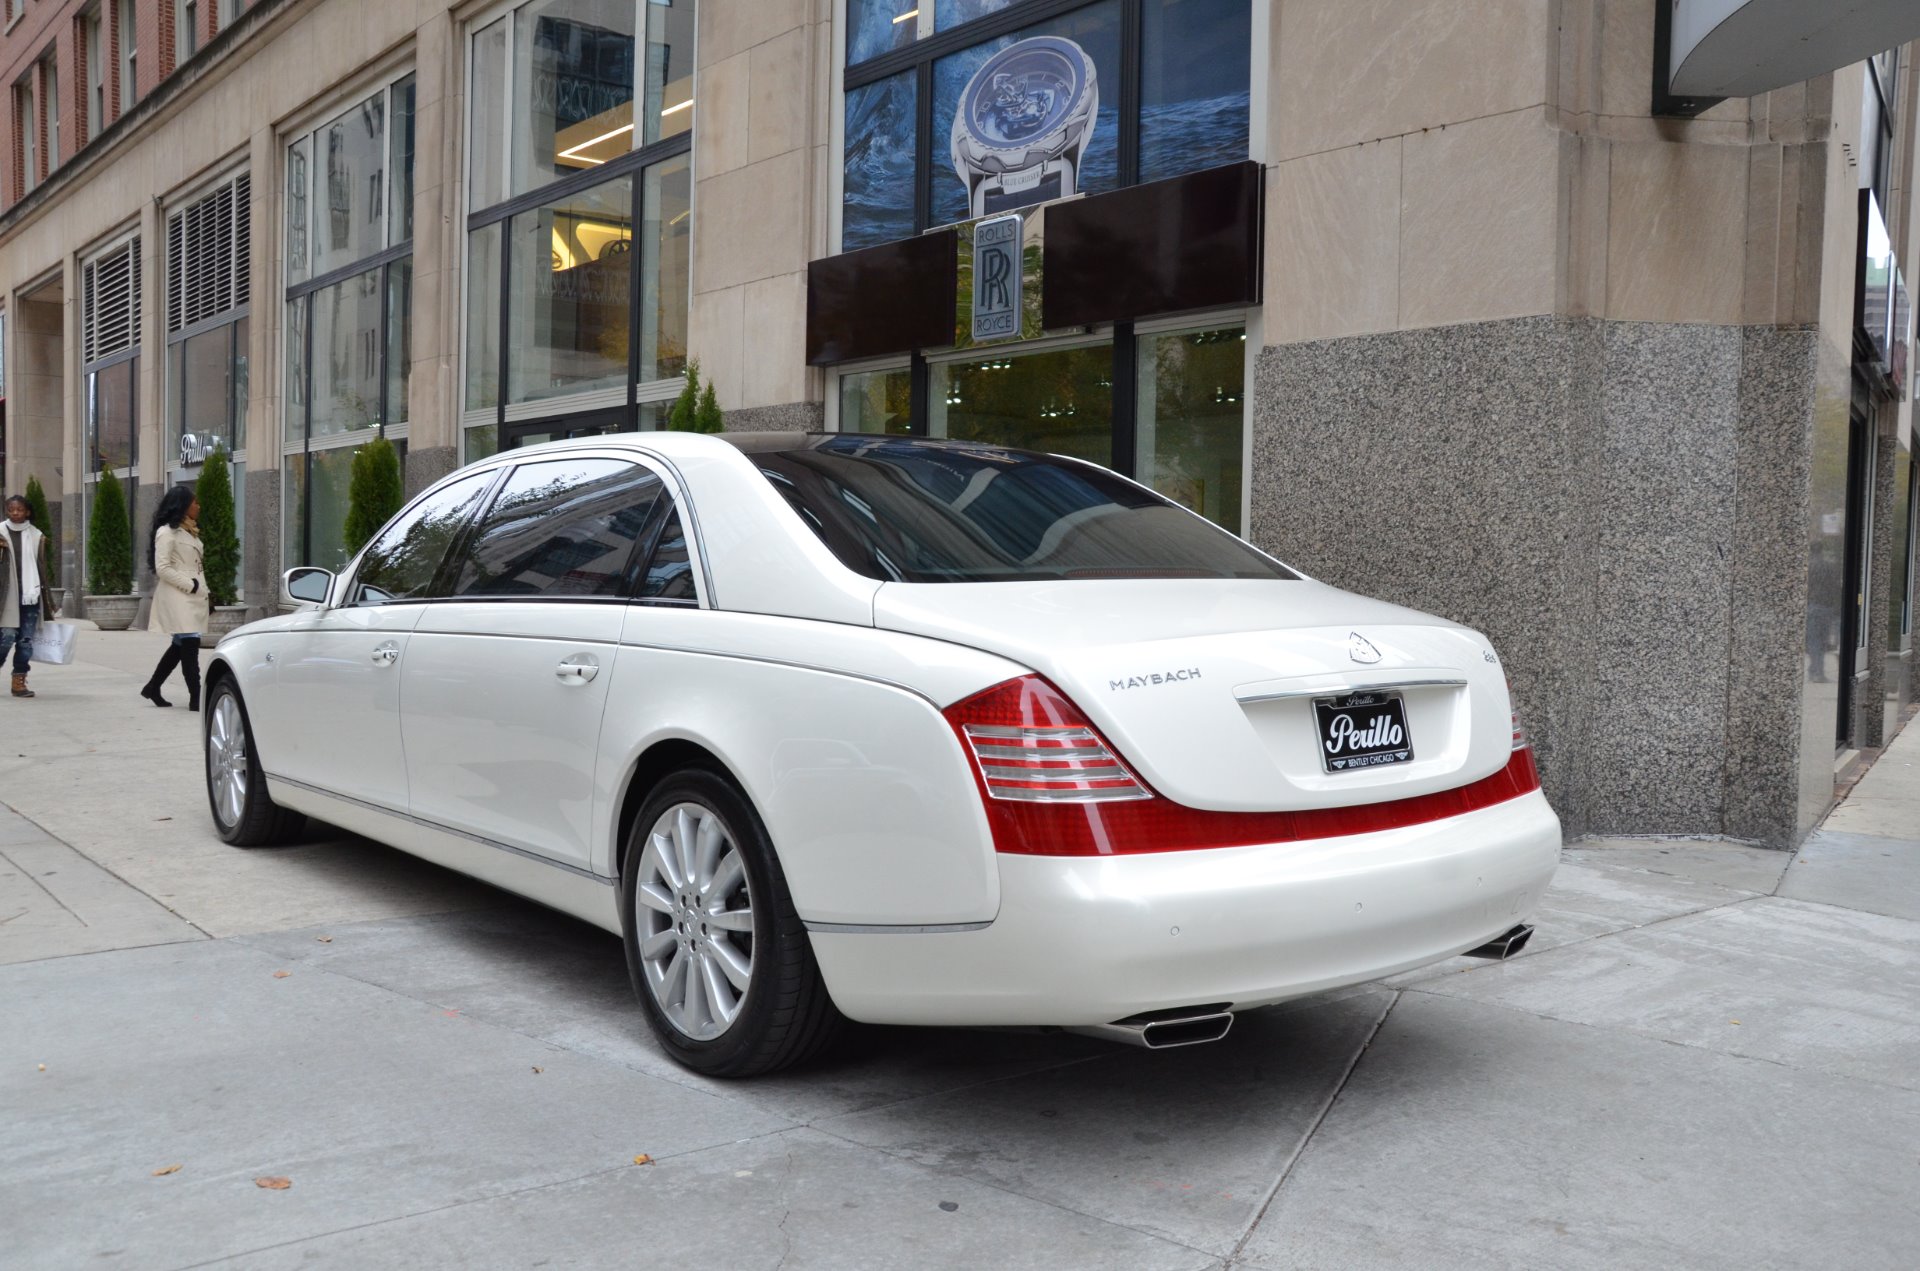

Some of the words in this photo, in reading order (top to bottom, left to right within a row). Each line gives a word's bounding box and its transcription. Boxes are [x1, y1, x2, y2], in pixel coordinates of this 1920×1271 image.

[979, 223, 1013, 242] ROLLS
[976, 315, 1012, 332] ROYCE
[1109, 667, 1202, 691] MAYBACH
[1346, 695, 1375, 706] Perillo
[1325, 714, 1403, 754] Perillo
[1348, 757, 1369, 768] BENTLEY
[1369, 753, 1395, 765] CHICAGO
